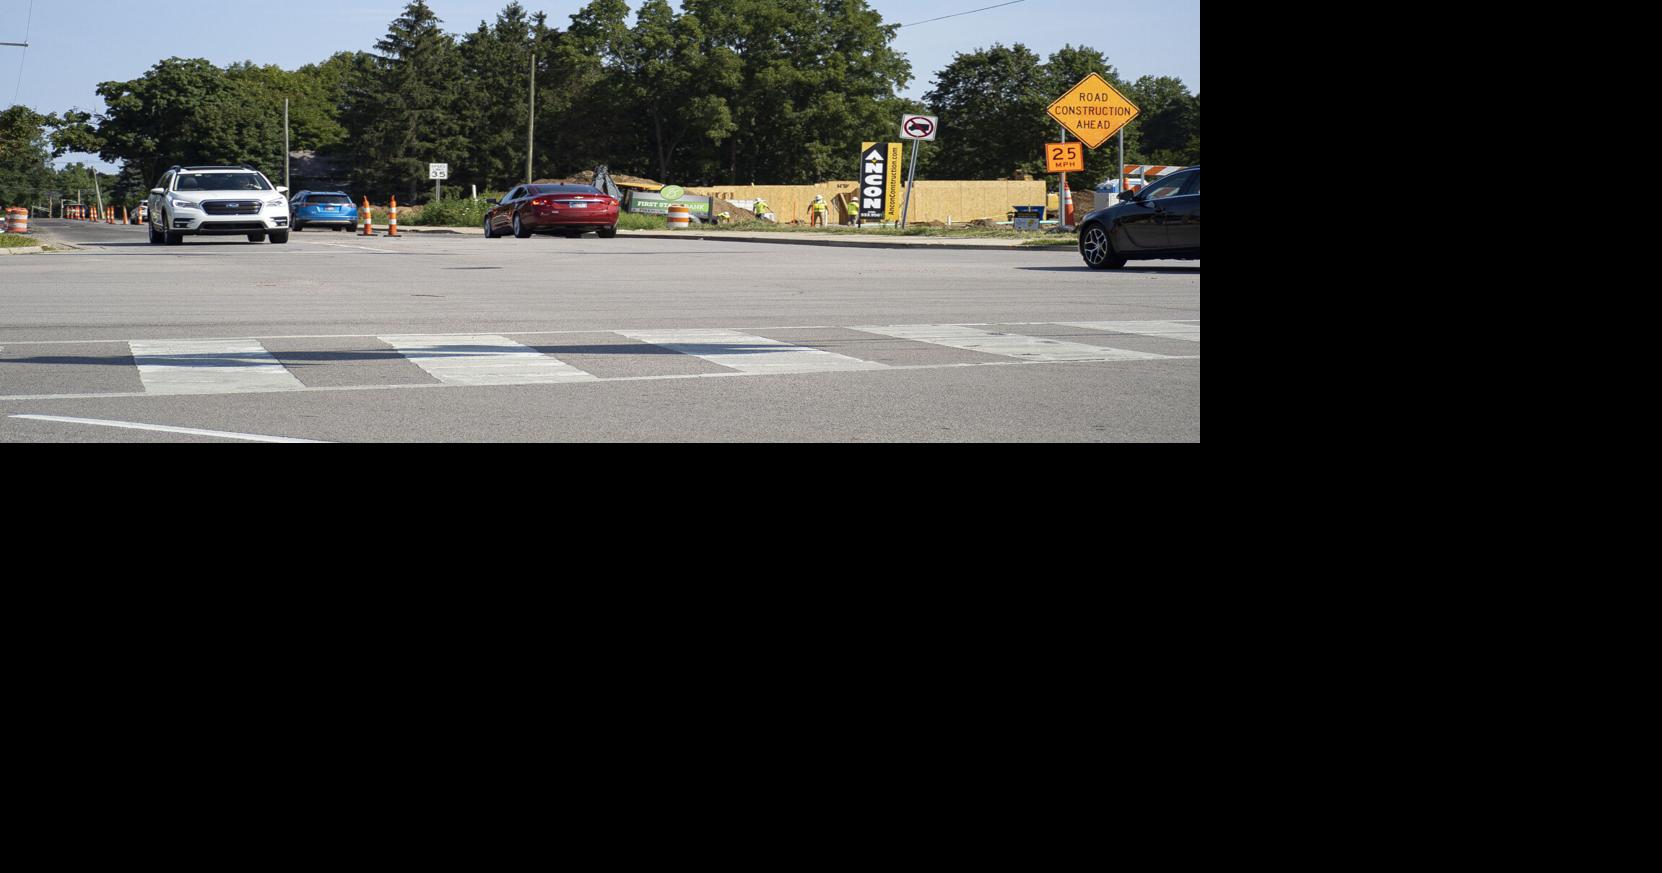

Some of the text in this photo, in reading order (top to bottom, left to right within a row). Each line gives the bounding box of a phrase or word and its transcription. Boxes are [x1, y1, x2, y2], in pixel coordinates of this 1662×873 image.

[1079, 92, 1109, 102] ROAD
[1054, 105, 1132, 116] CONSTRUCTION
[1076, 120, 1111, 130] AHEAD
[1052, 147, 1076, 161] 25
[864, 150, 884, 209] ANCON
